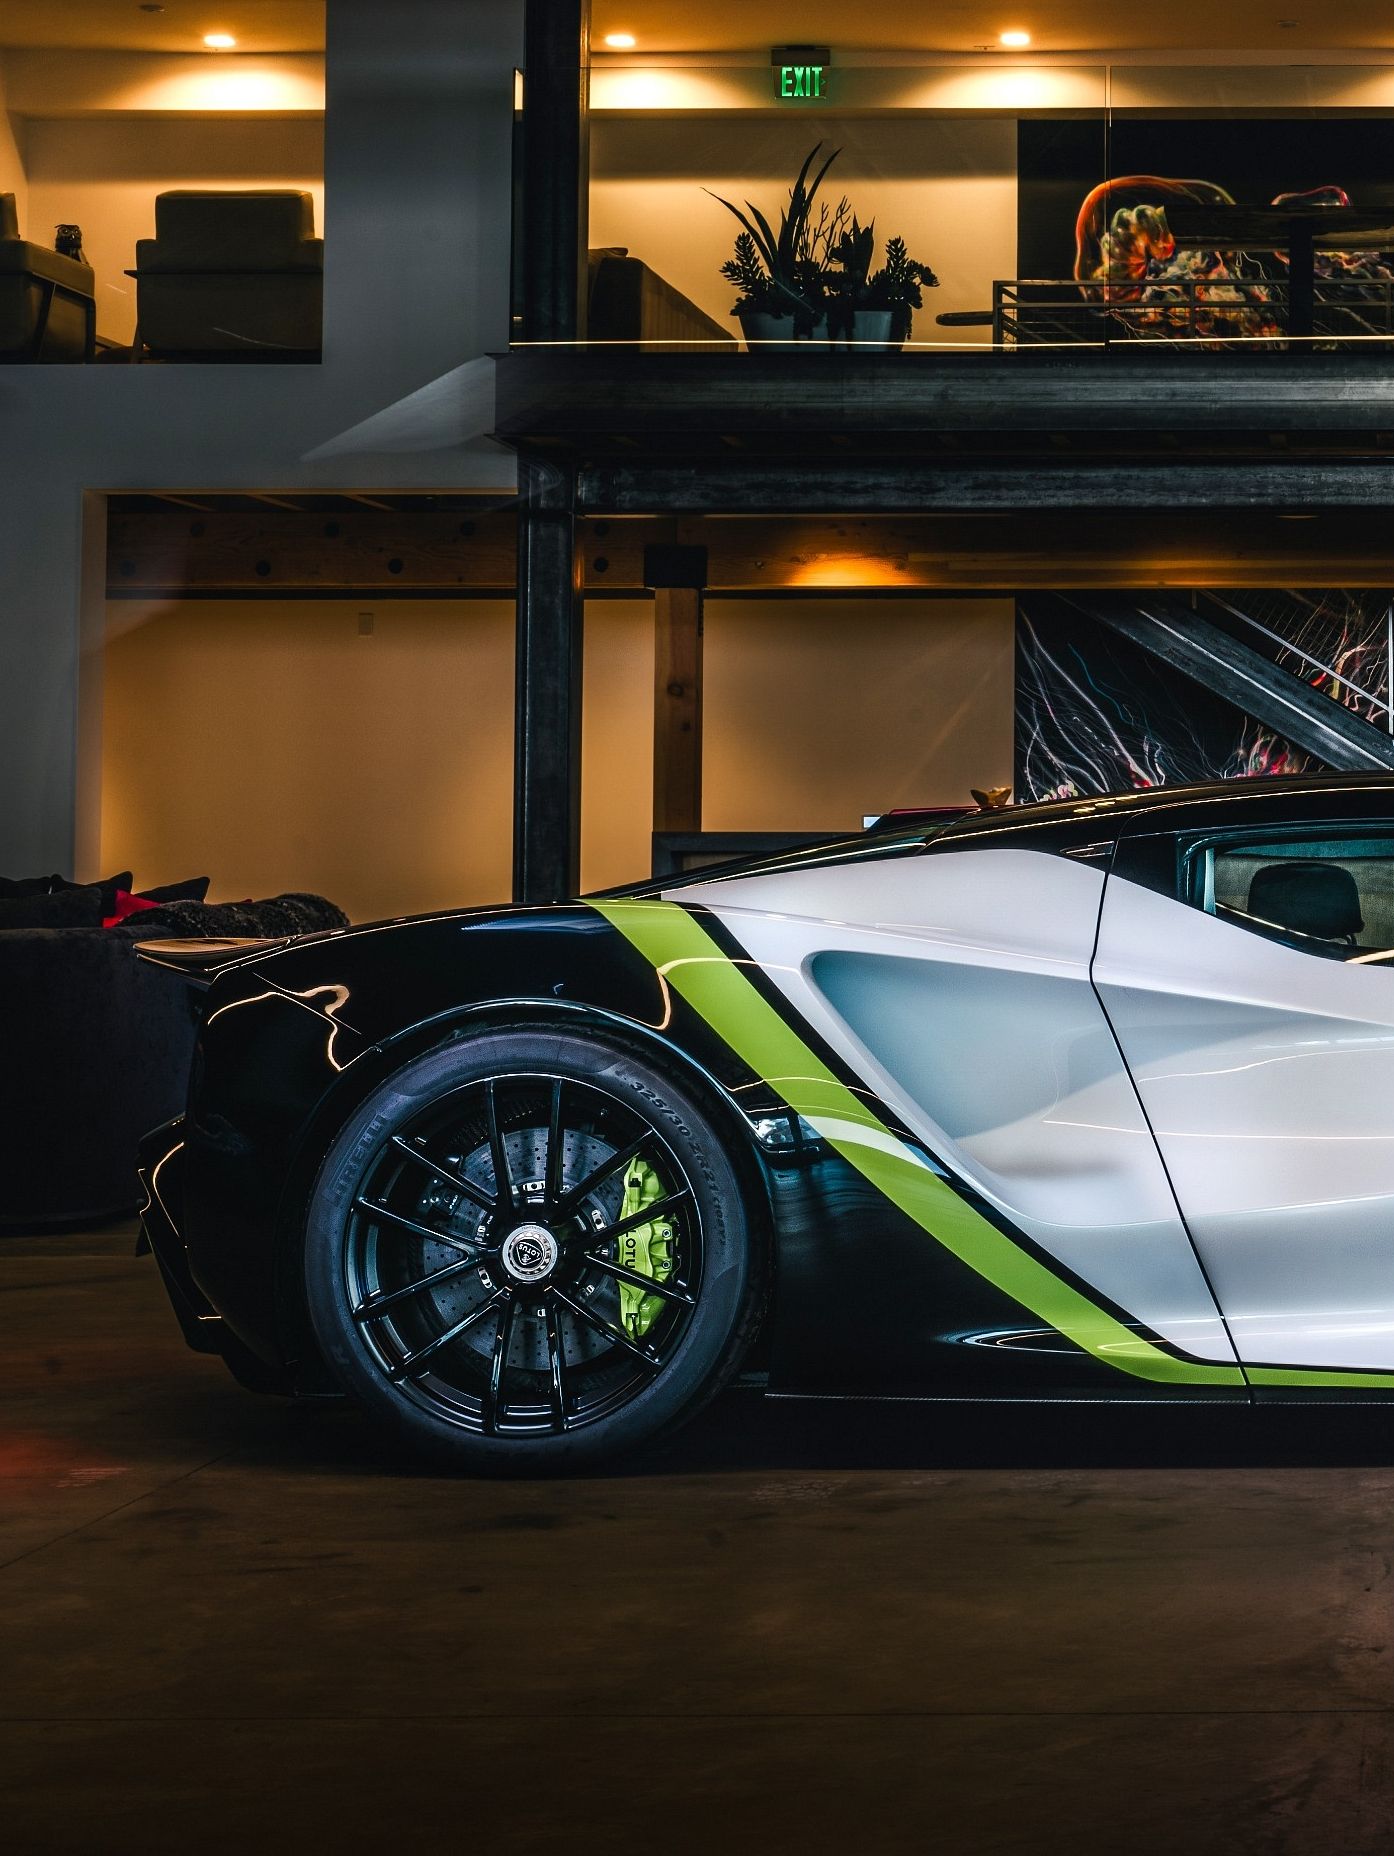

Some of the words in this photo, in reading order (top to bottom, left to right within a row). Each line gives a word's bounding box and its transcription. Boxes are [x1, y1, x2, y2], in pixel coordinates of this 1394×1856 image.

[781, 66, 823, 97] EXIT
[631, 1082, 691, 1137] 325/30
[687, 1141, 719, 1192] ZR21
[518, 1243, 541, 1258] LOTUS
[624, 1229, 637, 1270] LOTU
